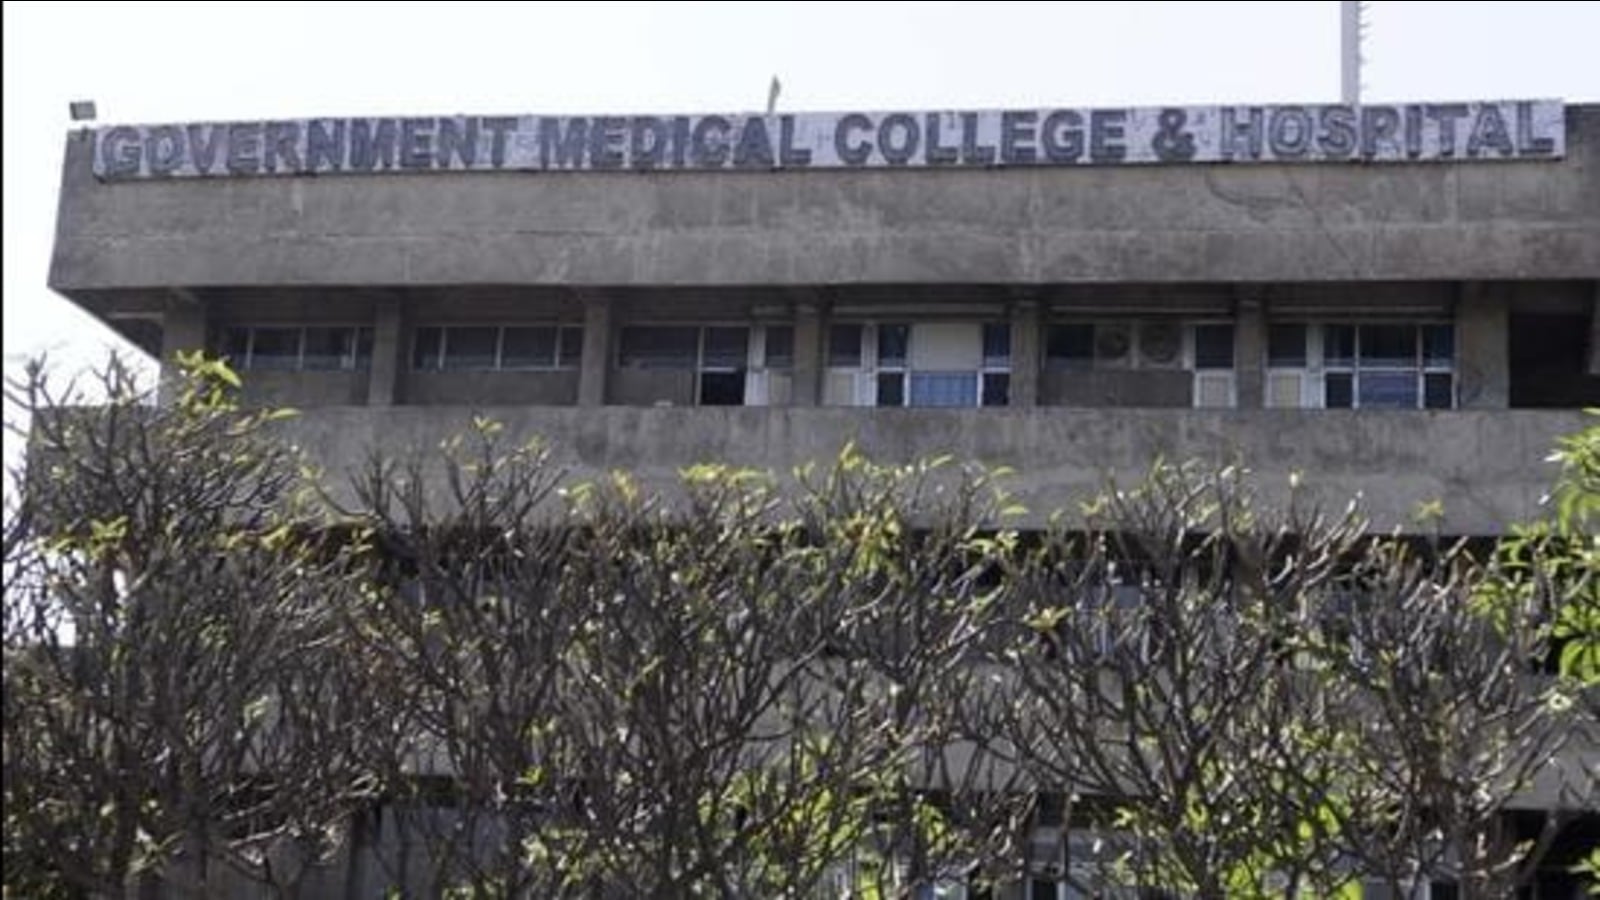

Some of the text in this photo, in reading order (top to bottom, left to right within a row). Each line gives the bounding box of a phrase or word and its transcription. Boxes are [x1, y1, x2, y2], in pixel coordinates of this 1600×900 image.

[101, 103, 1555, 174] GOVERNMENT MEDICAL COLLEGE & HOSPITAL
